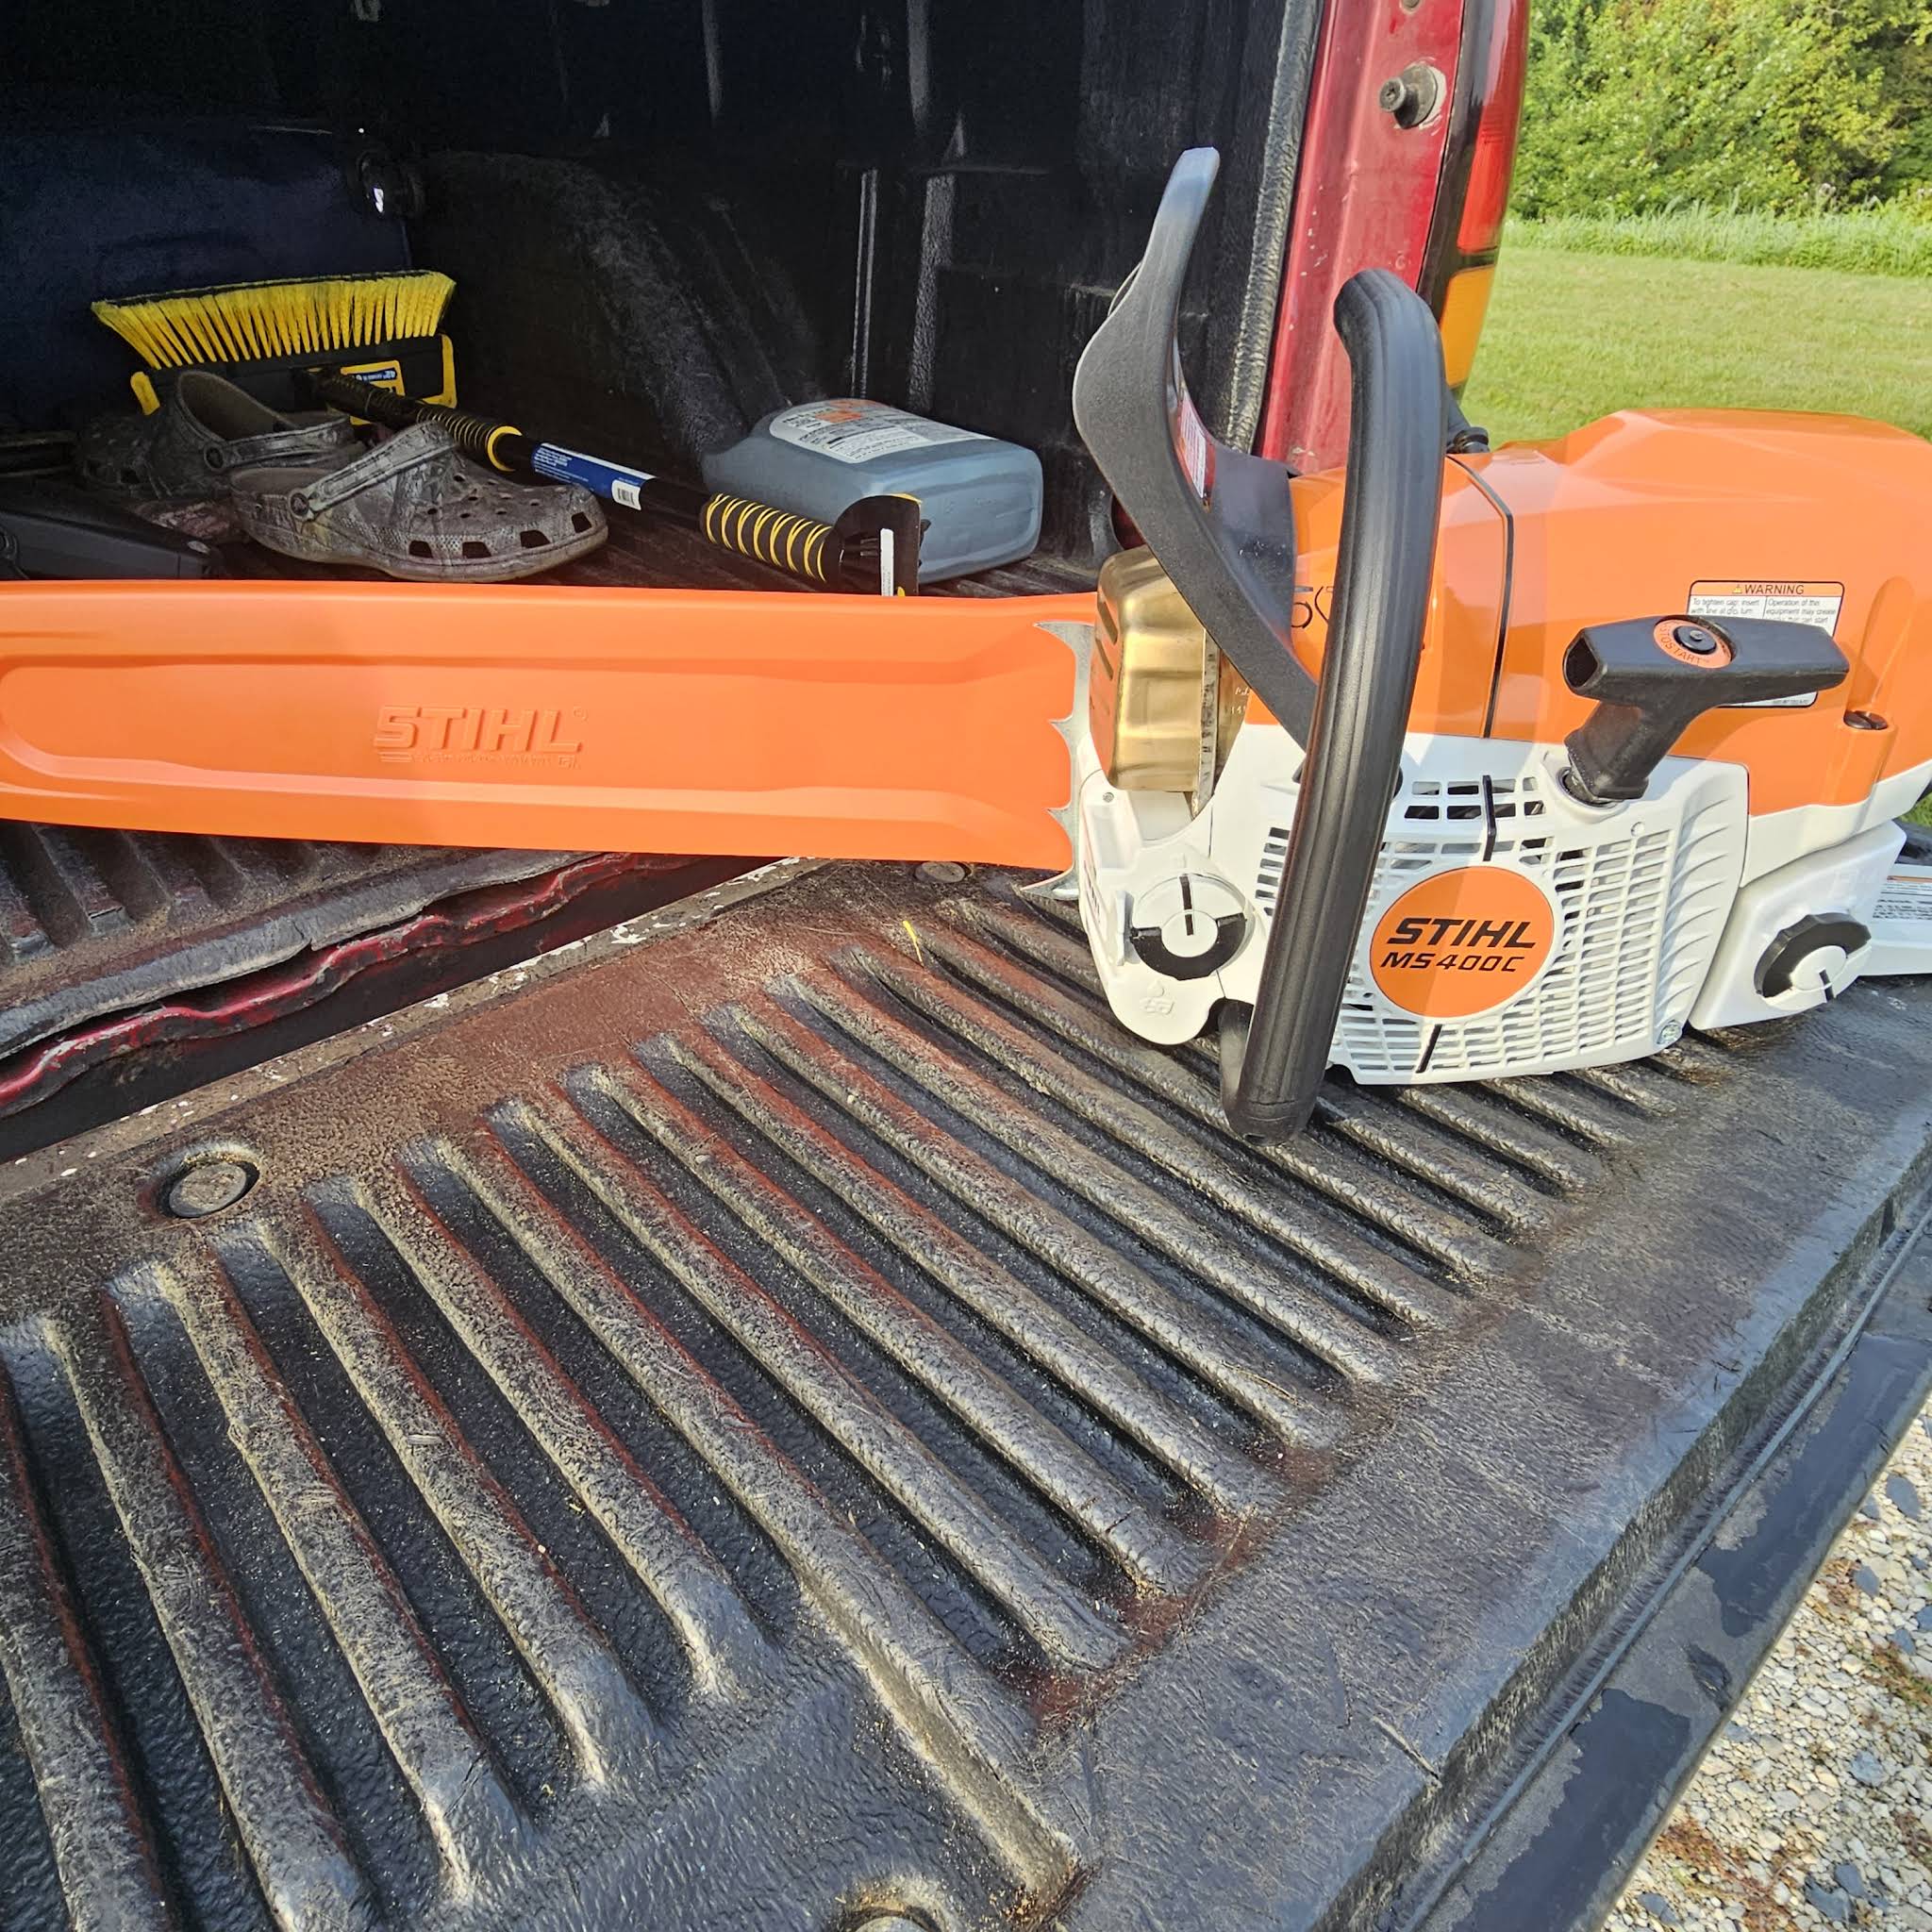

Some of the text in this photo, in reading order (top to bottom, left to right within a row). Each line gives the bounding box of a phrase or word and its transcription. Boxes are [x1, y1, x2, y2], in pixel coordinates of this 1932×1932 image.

[1744, 584, 1805, 595] WARNING
[1768, 598, 1799, 607] Operation
[374, 706, 584, 754] STIHL
[1387, 917, 1537, 949] STIHL
